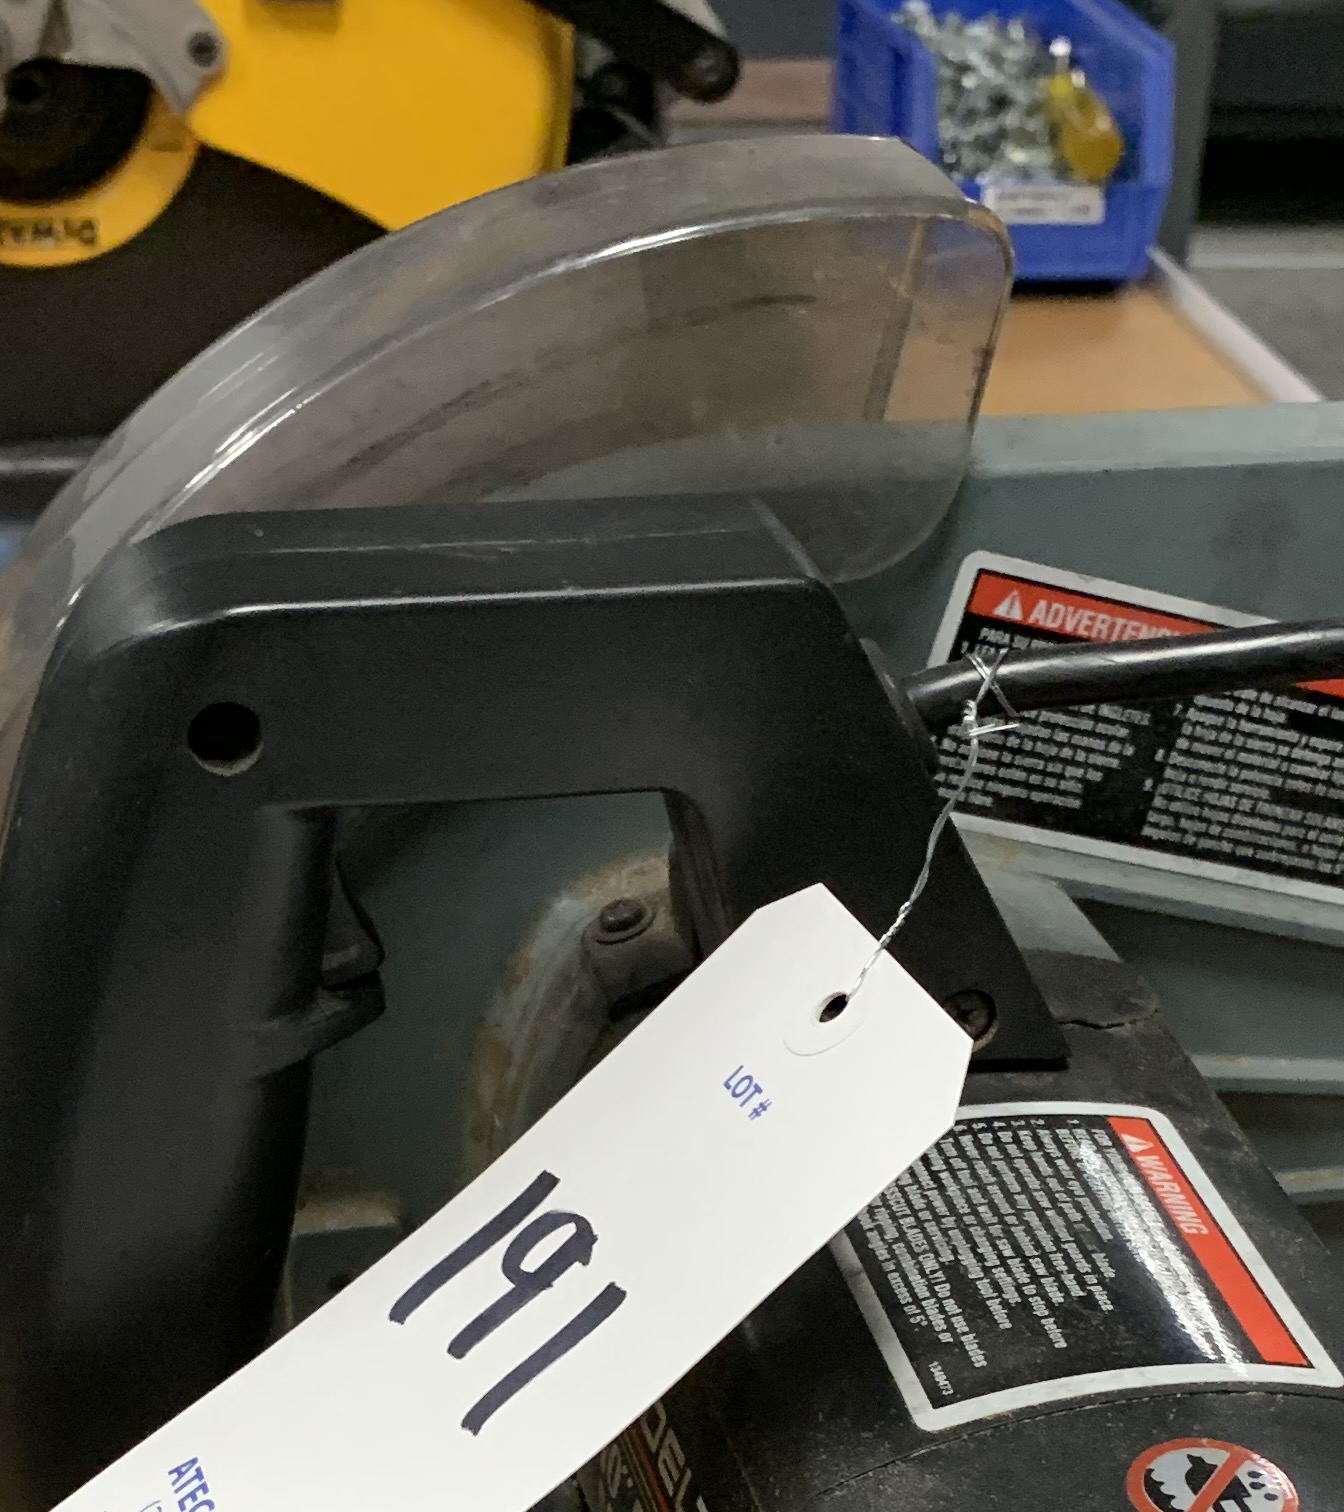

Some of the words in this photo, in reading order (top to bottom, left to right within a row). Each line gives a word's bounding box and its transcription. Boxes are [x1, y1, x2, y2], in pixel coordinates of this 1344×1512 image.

[722, 1065, 763, 1108] LOT
[747, 1096, 773, 1122] #
[996, 1130, 1013, 1142] Do
[1016, 1129, 1037, 1151] Keep
[1136, 1154, 1209, 1236] WARNING
[898, 1216, 929, 1252] BLADES
[995, 1238, 1015, 1256] saw
[968, 1225, 1000, 1266] changing
[991, 1266, 1021, 1306] settings.
[1006, 1257, 1030, 1283] blade
[1028, 1257, 1049, 1275] saw
[1060, 1242, 1091, 1273] guards
[891, 1242, 930, 1298] combination
[921, 1297, 947, 1331] blades
[937, 1331, 953, 1342] or
[933, 1282, 951, 1298] Do
[1021, 1283, 1036, 1295] to
[1082, 1274, 1098, 1284] in
[389, 1169, 628, 1435] 191
[887, 1271, 912, 1304] excess
[903, 1304, 921, 1315] of
[941, 1297, 962, 1315] not
[1027, 1295, 1049, 1316] stop
[1086, 1285, 1113, 1311] place.
[950, 1315, 969, 1333] use
[985, 1297, 1012, 1329] before
[1040, 1317, 1067, 1348] before
[960, 1332, 987, 1367] blades
